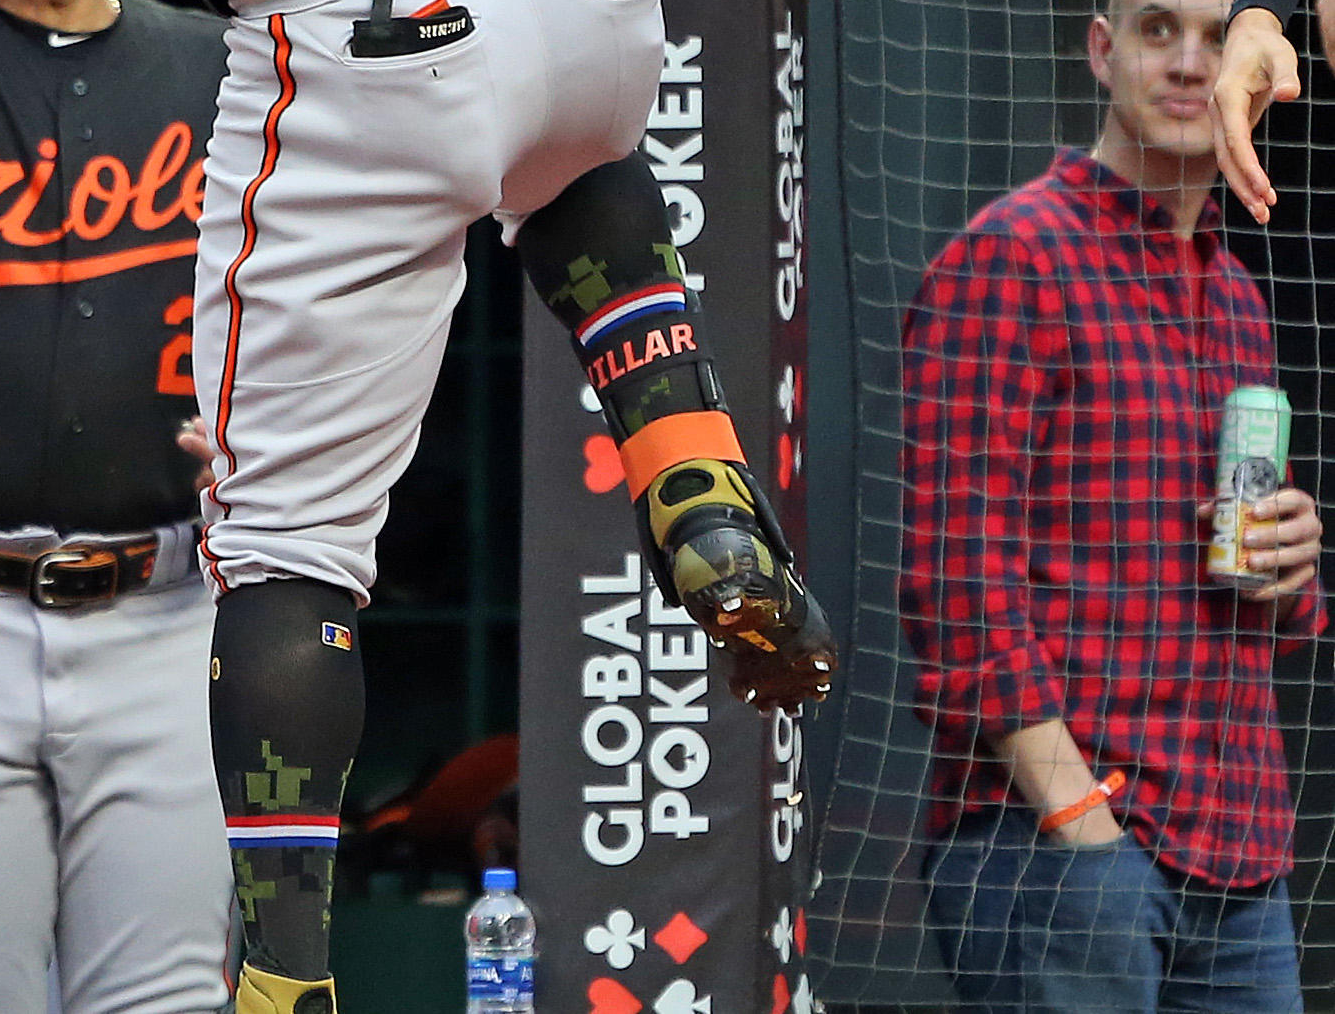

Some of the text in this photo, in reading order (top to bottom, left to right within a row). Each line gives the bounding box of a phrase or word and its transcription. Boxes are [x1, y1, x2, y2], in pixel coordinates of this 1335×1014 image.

[775, 11, 796, 321] GLOBAL
[587, 322, 698, 390] ILLAR
[581, 553, 645, 866] GLOBAL
[772, 706, 794, 862] GLO
